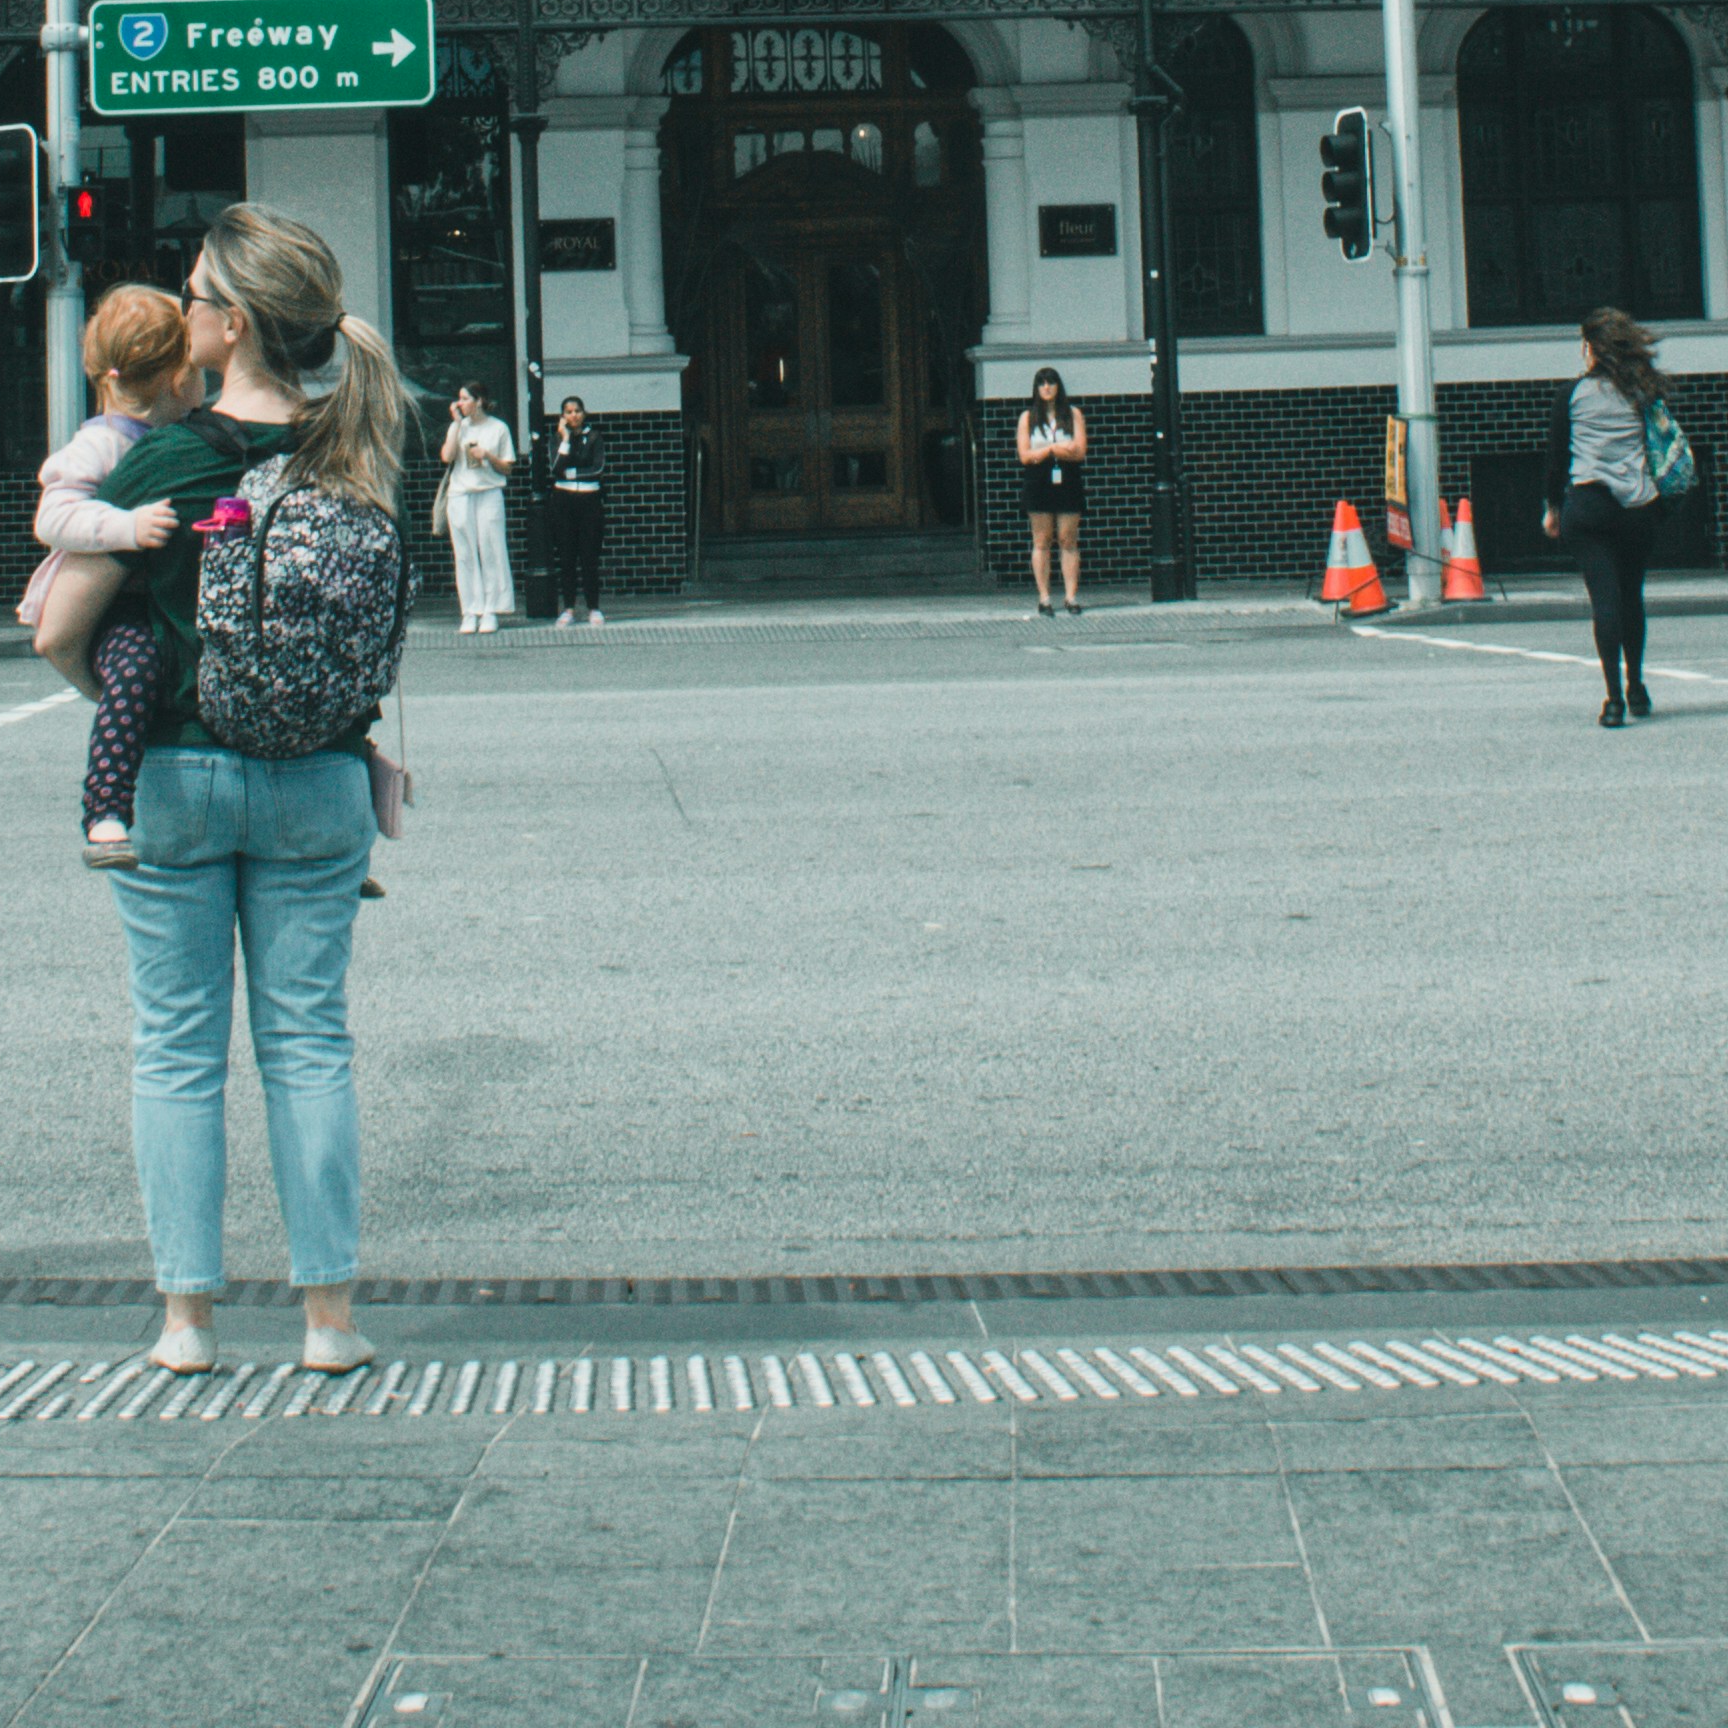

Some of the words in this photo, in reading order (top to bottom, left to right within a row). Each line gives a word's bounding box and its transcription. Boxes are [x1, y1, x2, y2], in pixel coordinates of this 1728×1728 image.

[132, 22, 154, 48] 2
[187, 24, 338, 50] Freeway
[110, 68, 241, 96] ENTRIES
[257, 65, 319, 91] 800
[337, 71, 359, 87] m
